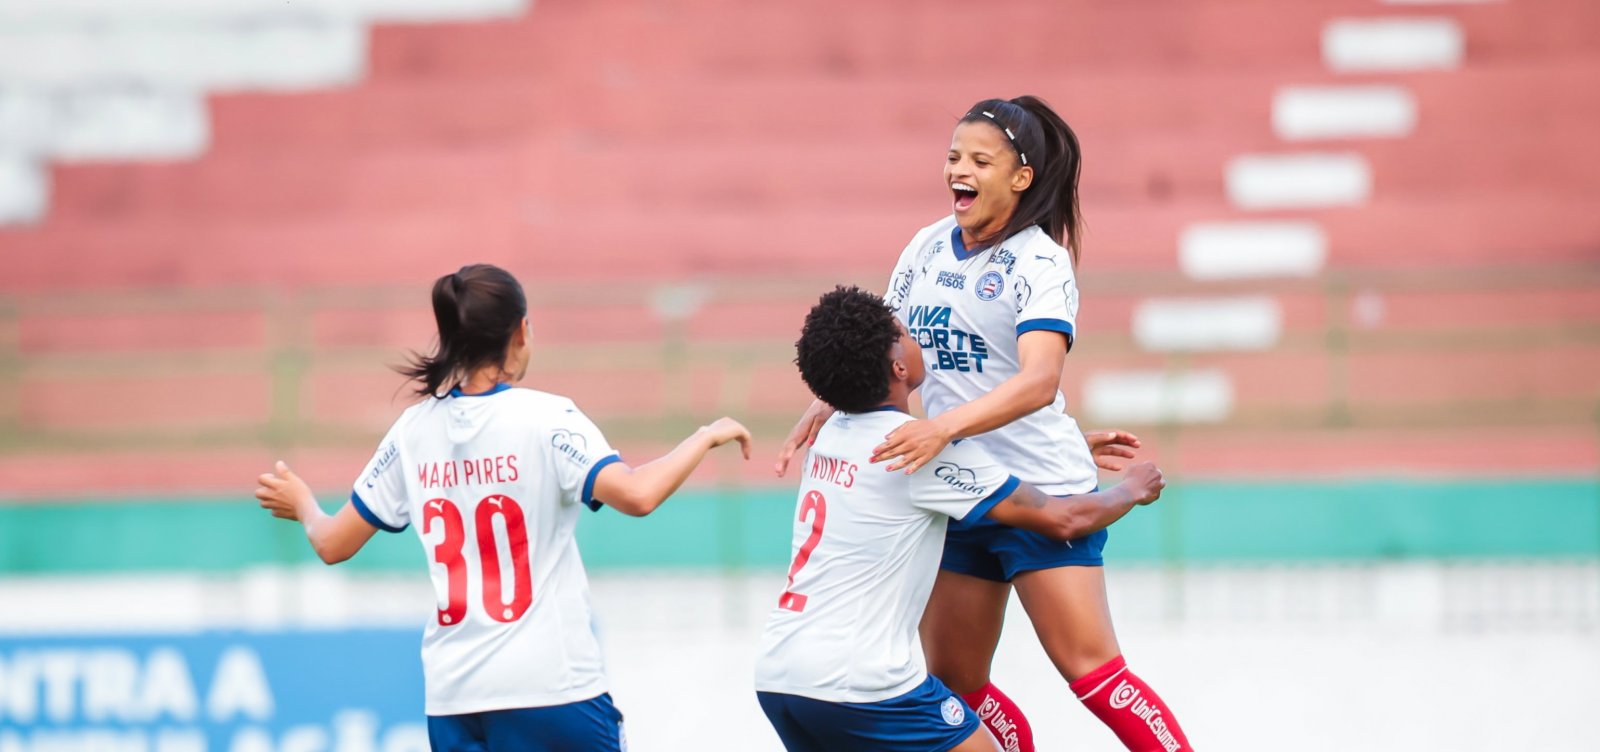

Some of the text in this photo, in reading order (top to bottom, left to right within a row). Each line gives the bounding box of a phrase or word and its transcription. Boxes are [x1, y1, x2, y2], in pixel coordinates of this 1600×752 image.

[935, 276, 965, 290] PISOS
[908, 305, 952, 328] VIVA
[909, 327, 988, 353] SORTE
[931, 350, 989, 374] .BET
[417, 454, 519, 489] MARI PIRES
[809, 452, 859, 488] NUNES
[422, 493, 534, 627] 30
[778, 489, 827, 613] 2
